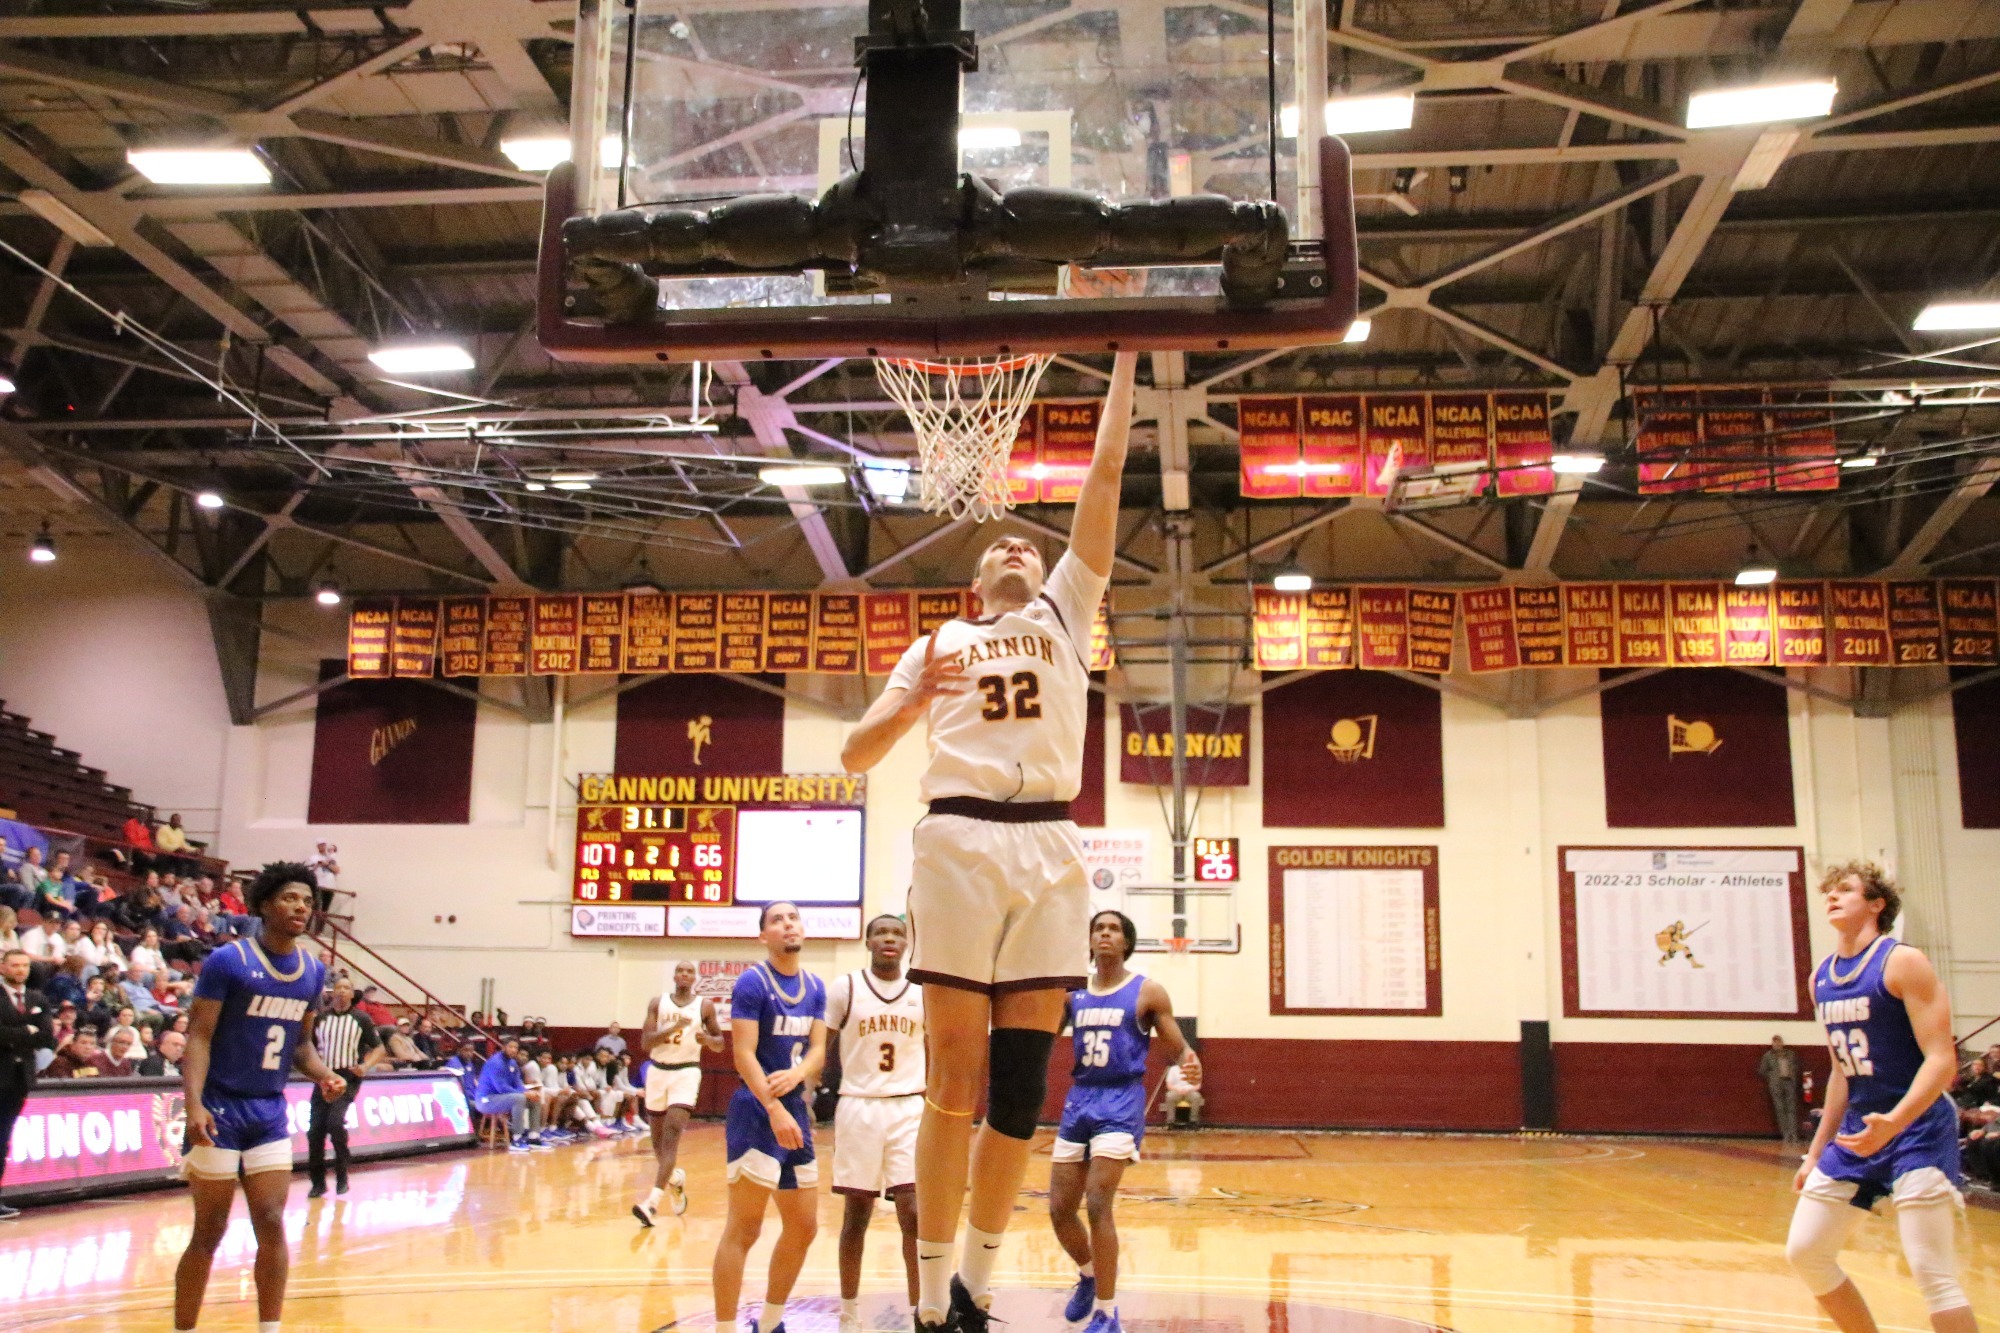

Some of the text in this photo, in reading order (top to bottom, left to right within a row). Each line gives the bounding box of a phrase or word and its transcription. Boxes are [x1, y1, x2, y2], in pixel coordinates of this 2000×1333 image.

[1049, 410, 1092, 424] PSAC
[1245, 412, 1289, 426] NCAA
[1310, 410, 1353, 426] PSAC
[1372, 406, 1420, 427] NCAA
[1436, 406, 1482, 422] NCAA
[1497, 405, 1544, 421] NCAA
[681, 598, 712, 610] PSAC
[726, 598, 760, 610] NCAA
[1259, 597, 1298, 615] NCAA
[1312, 592, 1346, 606] NCAA
[1361, 599, 1404, 613] NCAA
[1413, 594, 1450, 610] NCAA
[1520, 591, 1556, 605] NCAA
[1571, 590, 1608, 608] NCAA
[1624, 593, 1660, 611] NCAA
[1677, 592, 1713, 611] NCAA
[1727, 591, 1767, 607] NCAA
[1781, 590, 1819, 607] NCAA
[1836, 588, 1880, 608] NCAA
[1948, 588, 1993, 608] NCAA
[540, 604, 572, 618] NCAA
[587, 601, 618, 613] NCAA
[772, 601, 806, 614] NCAA
[920, 600, 958, 614] NCAA
[355, 611, 389, 623] NCAA
[400, 610, 434, 622] NCAA
[1574, 630, 1599, 644] ELITE
[1576, 647, 1608, 661] 1993
[1627, 640, 1660, 657] 1994
[1681, 639, 1715, 656] 1995
[1729, 640, 1767, 659] 2009
[1784, 638, 1822, 655] 2010
[1843, 638, 1880, 655] 2011
[1901, 642, 1937, 660] 2012
[539, 653, 571, 669] 2012
[978, 670, 1043, 722] 32
[582, 776, 859, 802] GANNON UNIVERSITY
[625, 806, 673, 830] 31.1
[691, 833, 721, 843] GUEST
[581, 843, 617, 866] 107
[645, 845, 659, 865] 2
[694, 844, 722, 867] 66
[1277, 850, 1432, 867] GOLDEN KNIGHTS
[1201, 853, 1233, 880] 26
[1584, 874, 1643, 887] 2022-23
[1648, 874, 1705, 887] Scholar
[1720, 874, 1784, 887] Athletes
[581, 881, 599, 900] 10
[609, 881, 621, 900] 3
[684, 883, 694, 900] 1
[703, 883, 721, 901] 10
[597, 911, 637, 921] PRINTING
[246, 994, 309, 1022] LIONS
[1818, 996, 1870, 1026] LIONS
[859, 1014, 917, 1038] GANNON
[1075, 1007, 1125, 1028] LIONS
[262, 1025, 286, 1070] 2
[1081, 1030, 1113, 1067] 35
[1829, 1027, 1874, 1078] 32
[879, 1042, 896, 1072] 3
[363, 1093, 433, 1127] COURT
